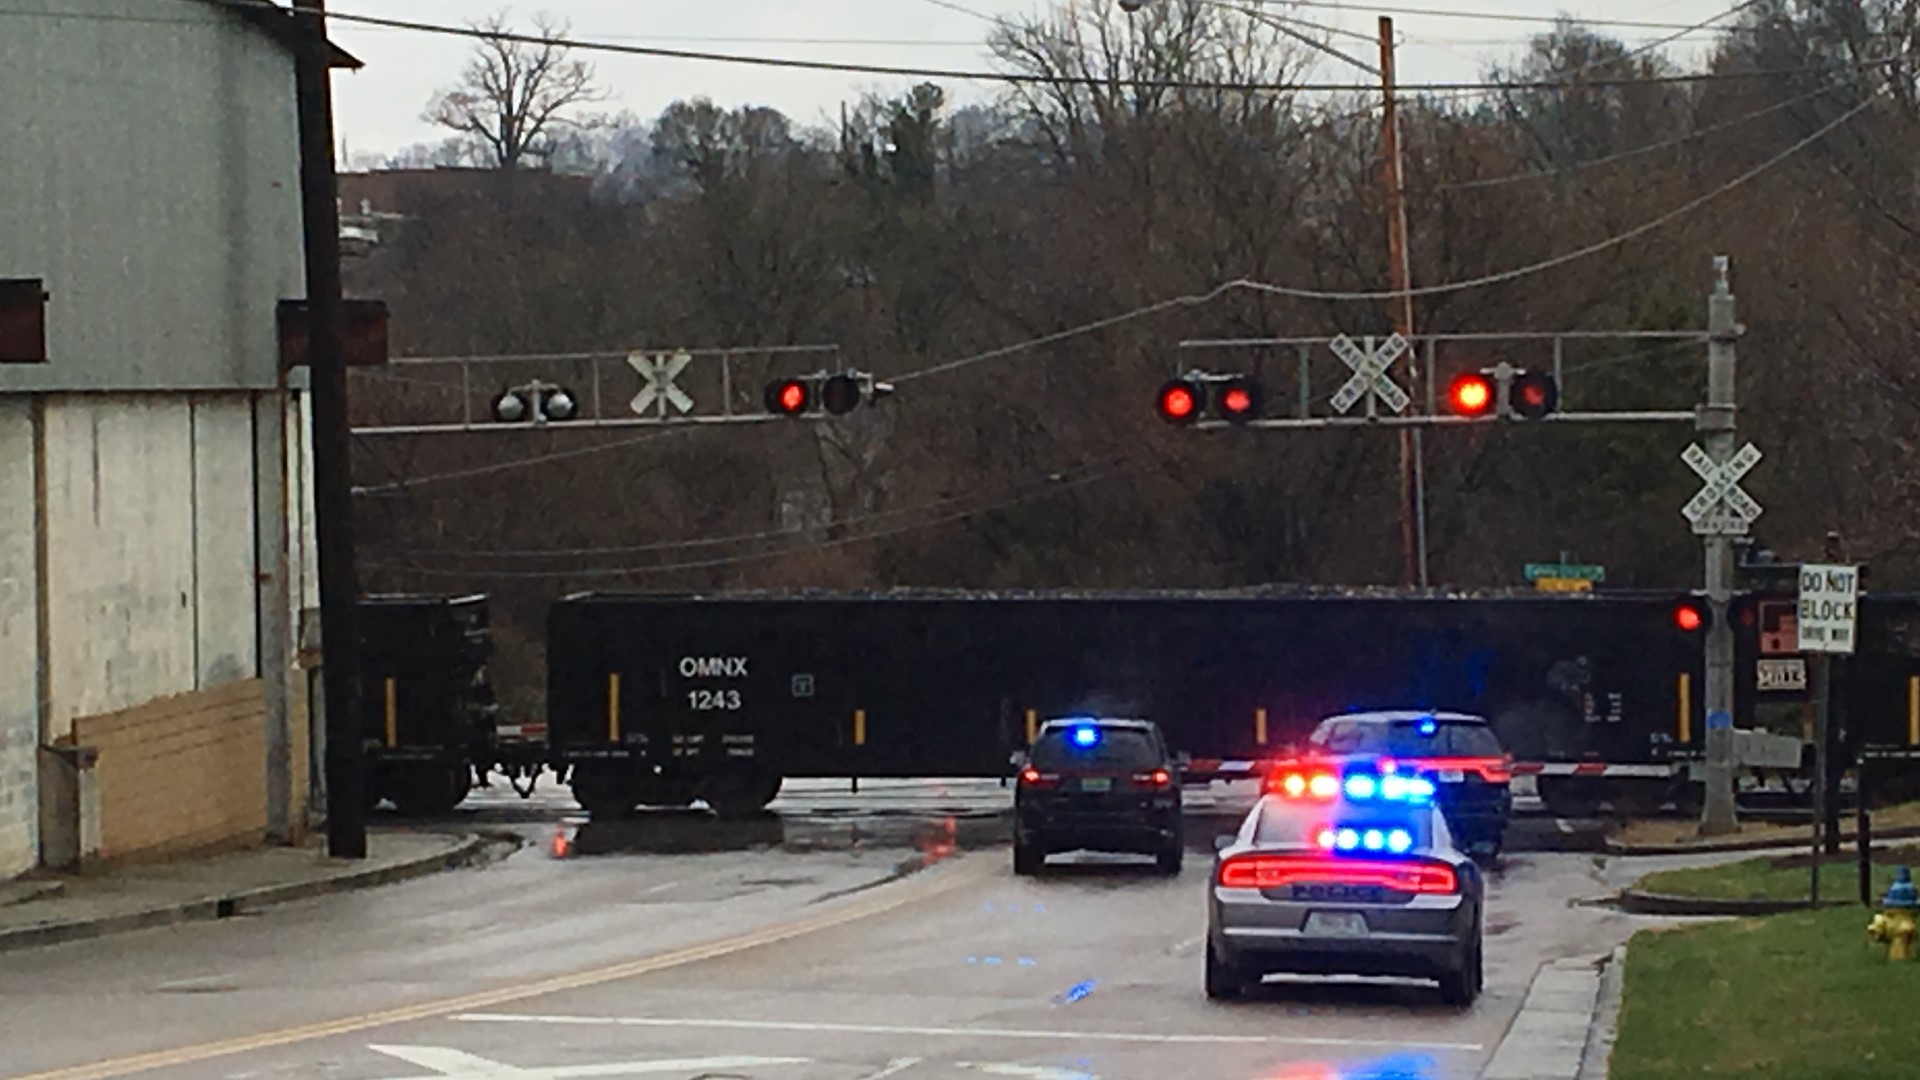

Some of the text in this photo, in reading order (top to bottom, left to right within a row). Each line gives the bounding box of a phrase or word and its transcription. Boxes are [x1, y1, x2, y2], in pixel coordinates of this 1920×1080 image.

[1802, 571, 1854, 594] DO NOT
[1801, 599, 1855, 622] BLOCK
[679, 657, 747, 677] OMNX
[688, 690, 741, 710] 1243
[1292, 885, 1380, 902] POLICE
